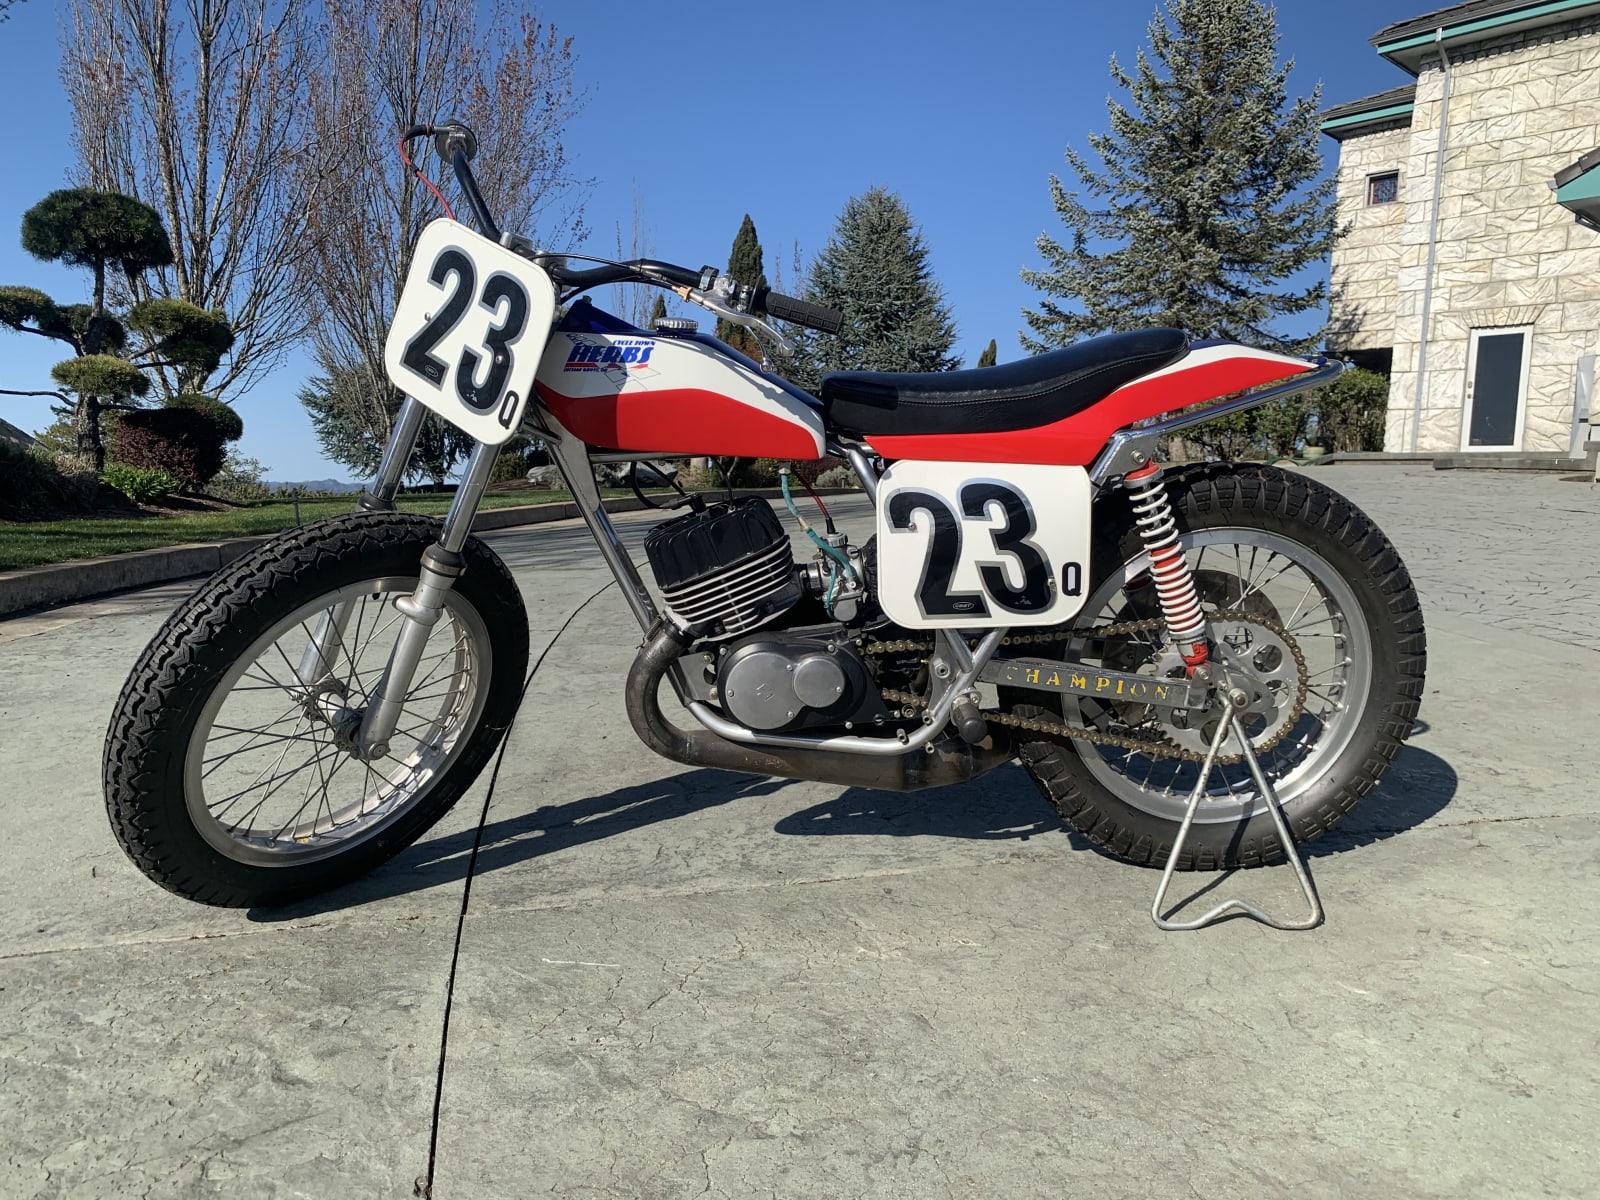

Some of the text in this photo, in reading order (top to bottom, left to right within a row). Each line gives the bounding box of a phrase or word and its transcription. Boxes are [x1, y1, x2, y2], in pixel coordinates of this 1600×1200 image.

[399, 245, 531, 416] 23
[567, 345, 654, 363] HERBS
[884, 477, 1058, 620] 23
[1061, 562, 1082, 597] Q
